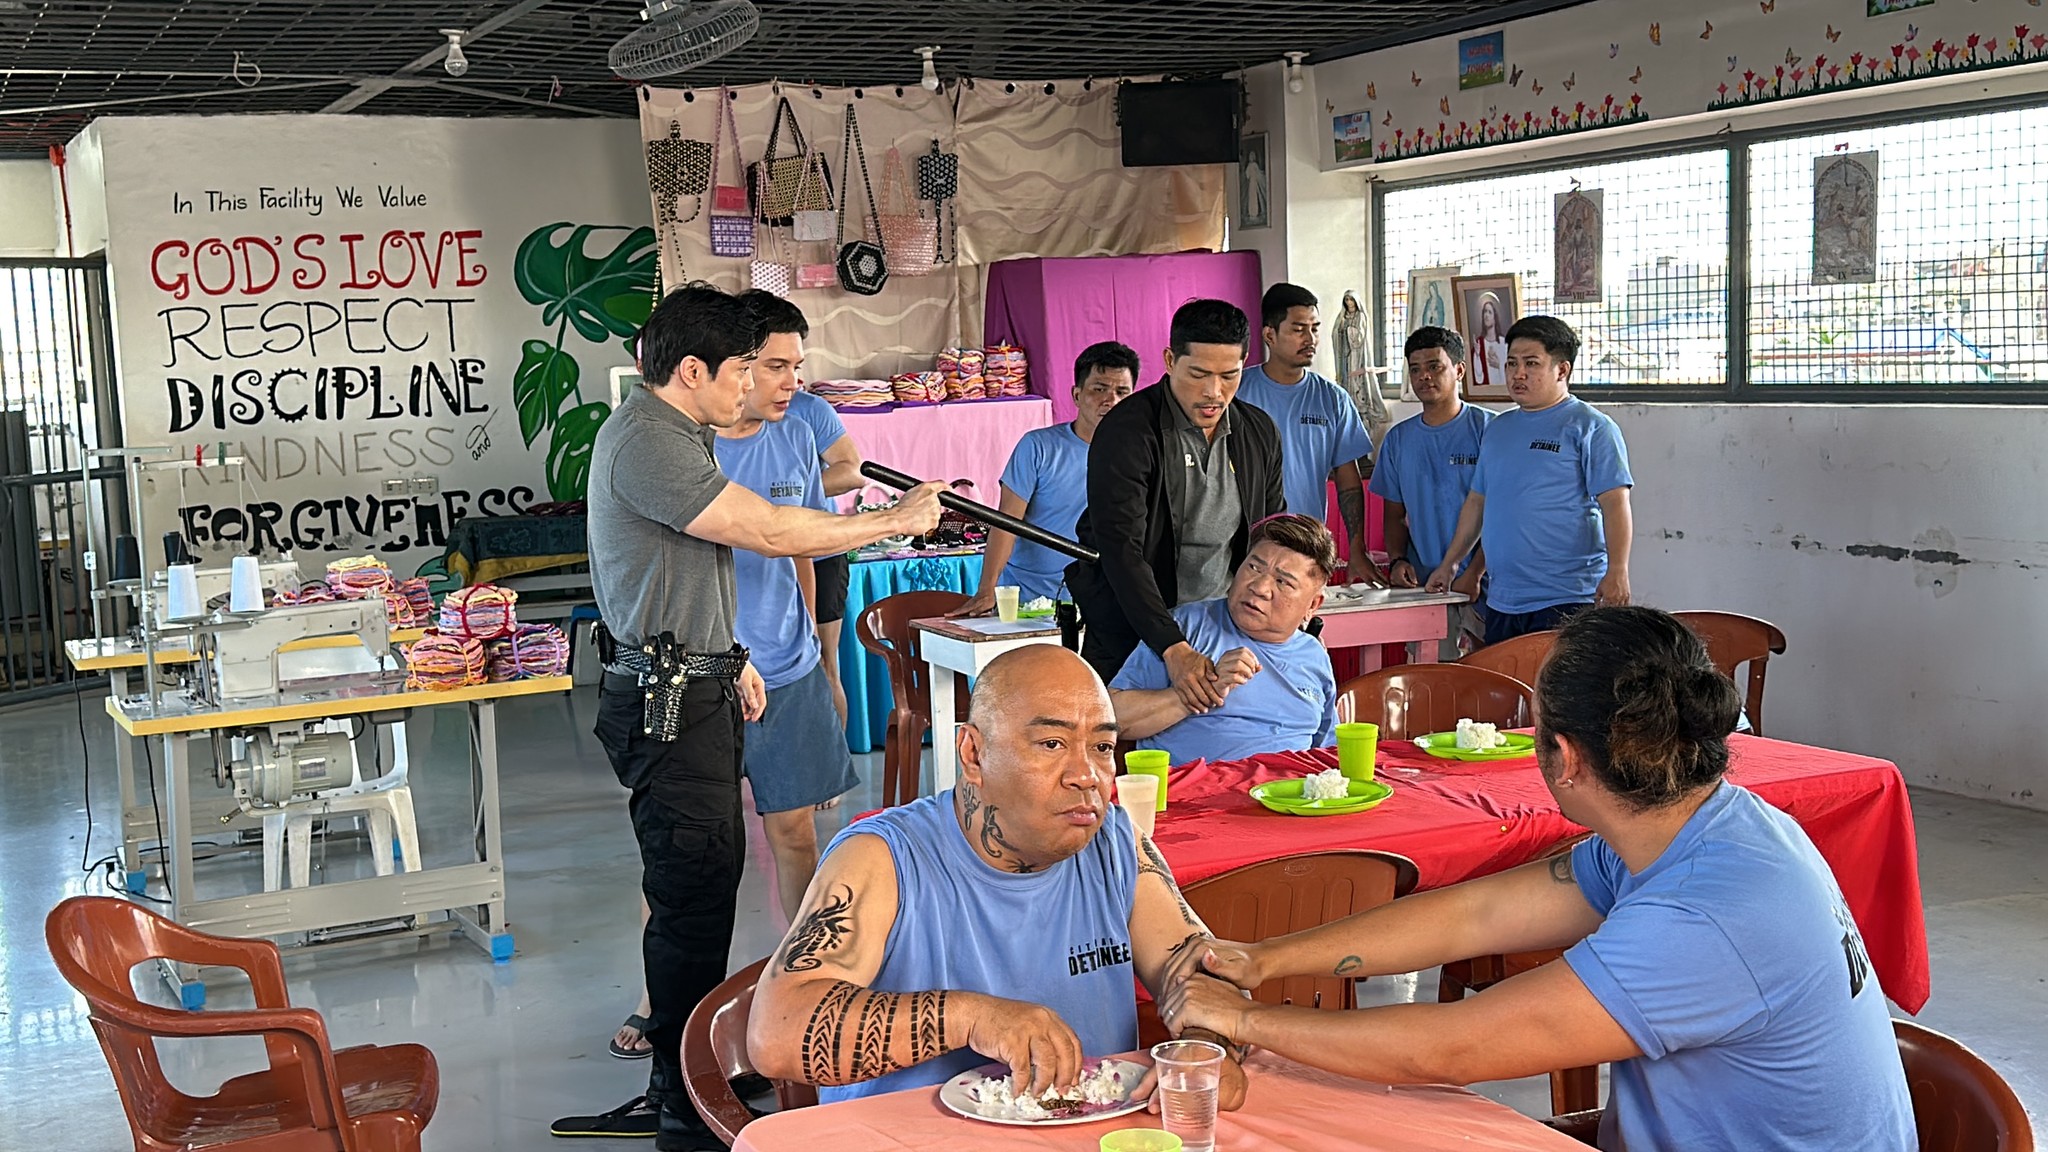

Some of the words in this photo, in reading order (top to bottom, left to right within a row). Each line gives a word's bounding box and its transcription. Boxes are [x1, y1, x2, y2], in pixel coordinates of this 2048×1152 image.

[173, 191, 193, 214] In
[205, 190, 248, 212] This
[259, 187, 323, 216] Facility
[336, 186, 364, 208] We
[378, 185, 427, 207] Value
[151, 233, 327, 300] GOD'S
[339, 229, 488, 290] LOVE
[157, 297, 476, 368] RESPECT
[167, 357, 489, 433] DISCIPLINE
[181, 426, 455, 487] KINDNESS
